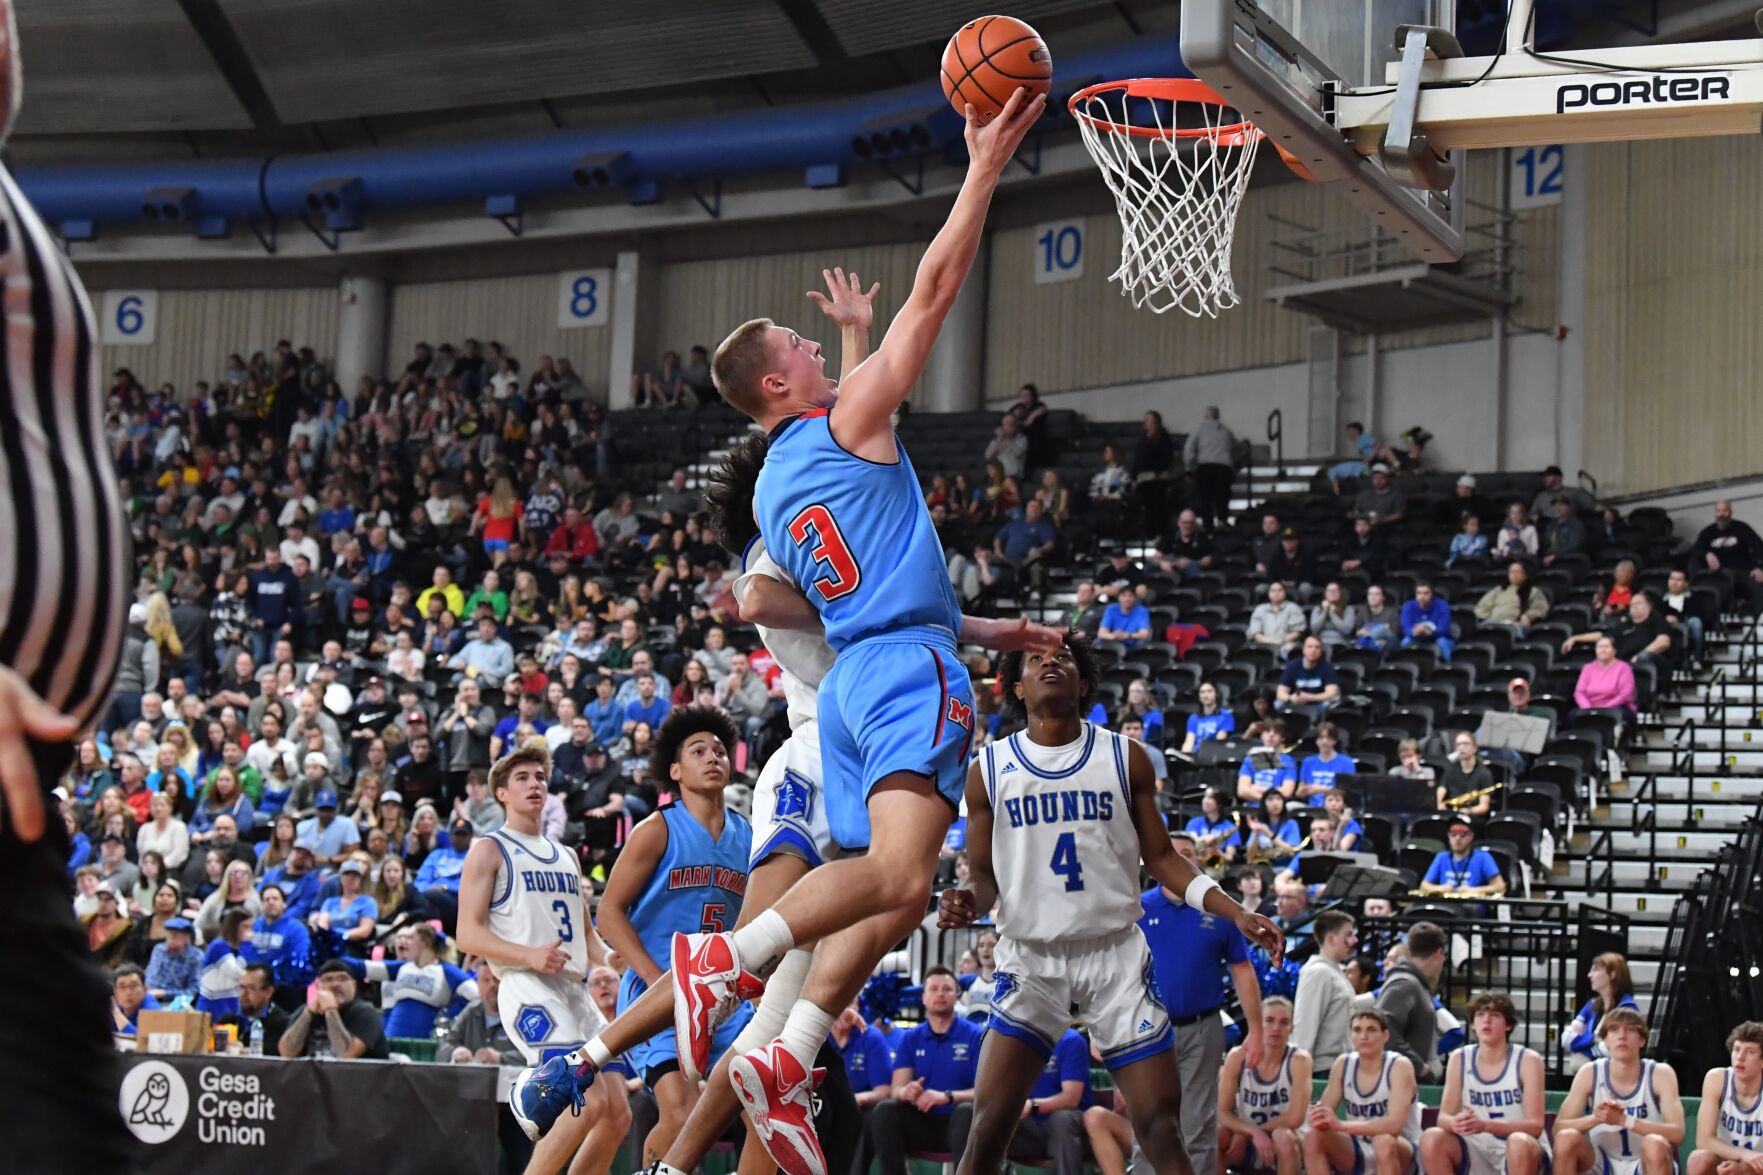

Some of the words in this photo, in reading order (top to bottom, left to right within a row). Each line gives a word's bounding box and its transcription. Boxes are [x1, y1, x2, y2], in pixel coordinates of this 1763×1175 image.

[1516, 144, 1564, 197] 12
[1038, 226, 1082, 272] 10
[116, 295, 144, 336] 6
[571, 276, 597, 319] 8
[787, 502, 862, 603] 3
[947, 695, 972, 731] M
[1004, 790, 1113, 828] HOUNDS
[668, 864, 712, 891] MARK
[1049, 832, 1085, 892] 4
[552, 899, 573, 942] 3
[700, 903, 726, 934] 5
[199, 1066, 260, 1094] Gesa
[197, 1092, 275, 1120] Credit
[198, 1118, 266, 1146] Union
